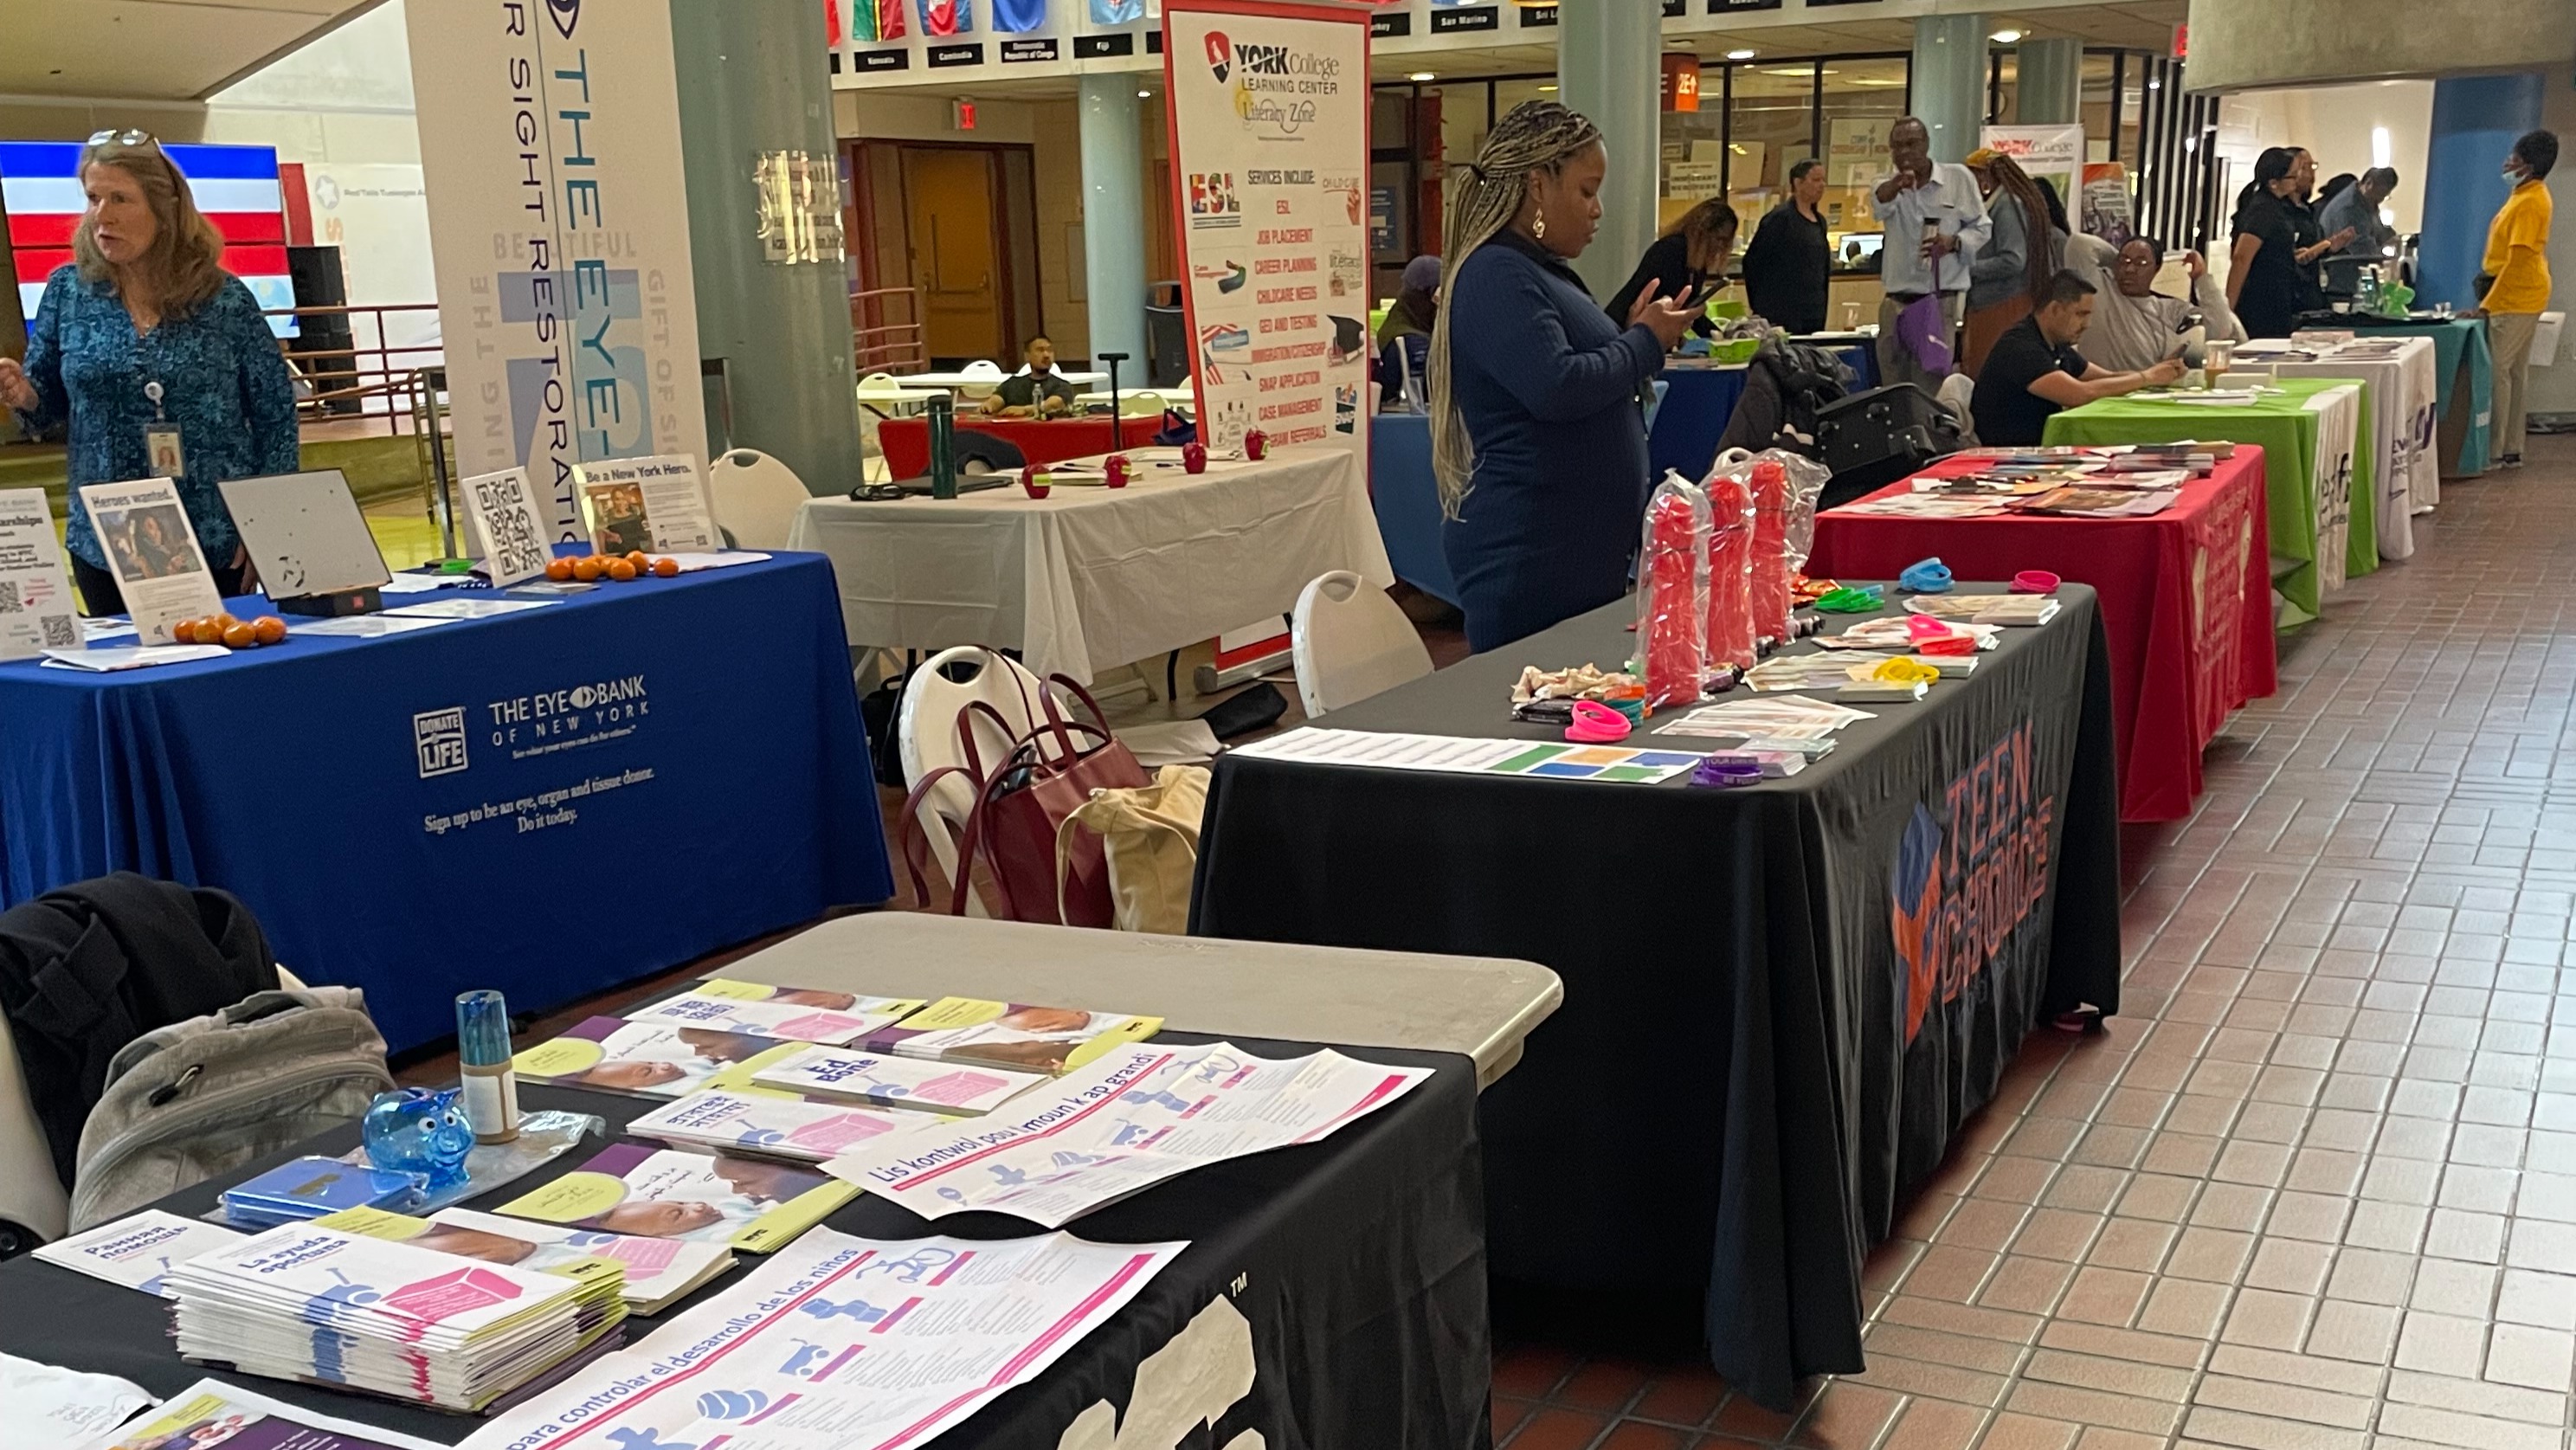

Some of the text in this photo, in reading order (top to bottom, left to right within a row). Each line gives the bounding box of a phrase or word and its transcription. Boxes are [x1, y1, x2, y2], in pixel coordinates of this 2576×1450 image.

[1371, 23, 1391, 32] rkey
[1440, 16, 1488, 26] San Marino
[1234, 44, 1340, 81] YORK College
[1241, 77, 1338, 95] LEARNING CENTER
[1289, 100, 1317, 123] Zone
[510, 57, 544, 222] SIGHT
[555, 48, 601, 229] THE
[1248, 170, 1282, 184] SERVICES
[1189, 172, 1240, 214] ESL
[493, 232, 638, 260] BEAUTIFUL
[1257, 229, 1313, 245] JOB PLACEMENT
[1254, 257, 1317, 274] CAREER PLANNING
[1274, 317, 1288, 331] AND
[1290, 314, 1317, 330] TESTING
[1259, 371, 1320, 392] SNAP APPLICATION
[1259, 397, 1323, 422] CASE MANAGEMENT
[586, 471, 601, 482] Be
[611, 467, 635, 480] New
[636, 466, 661, 477] York
[663, 464, 692, 474] Hero.
[91, 496, 131, 509] Heroes
[488, 674, 647, 725] THE EYE BANK
[419, 714, 460, 735] DONATE
[493, 701, 649, 746] OF NEW YORK
[422, 740, 463, 771] LIFE
[424, 768, 655, 835] Sign up to be an eye, organ and tissue donor.
[1947, 719, 2033, 880] TEEN
[518, 808, 578, 834] Do it today.
[868, 1158, 910, 1183] Lis
[979, 1126, 1015, 1147] pou
[1084, 1085, 1111, 1104] ap
[1104, 1053, 1158, 1086] grandi
[85, 1226, 166, 1257] Ранняя
[100, 1225, 189, 1260] помощь
[238, 1235, 332, 1270] La ayuda
[260, 1239, 351, 1275] oportuna
[1229, 1273, 1249, 1298] TM
[506, 1248, 860, 1450] para controlar el desarrollo de los niños
